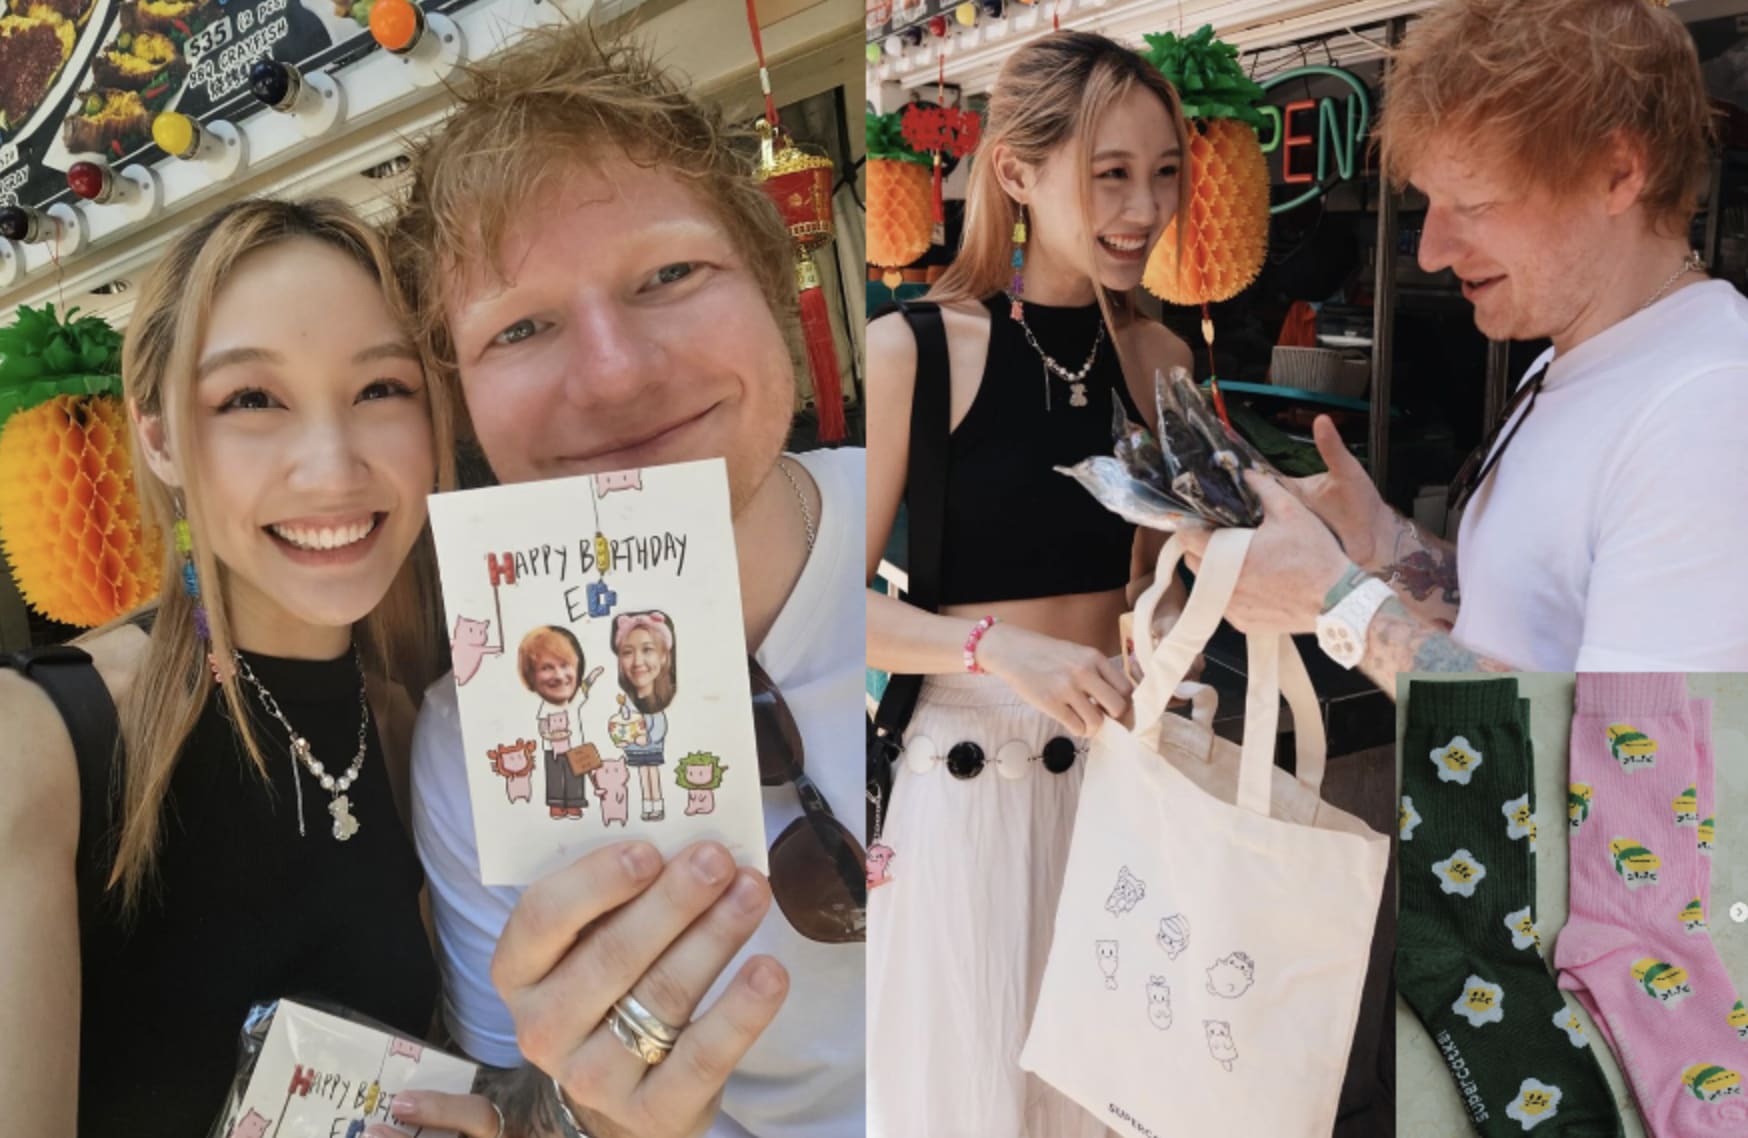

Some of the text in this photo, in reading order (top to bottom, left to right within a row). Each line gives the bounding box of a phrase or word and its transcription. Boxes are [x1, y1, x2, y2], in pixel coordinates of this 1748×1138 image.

[219, 17, 288, 70] CRAYFISH
[487, 531, 687, 586] HAPPY BIRTHDAY
[564, 583, 617, 622] ED
[289, 1064, 350, 1109] HAPPY
